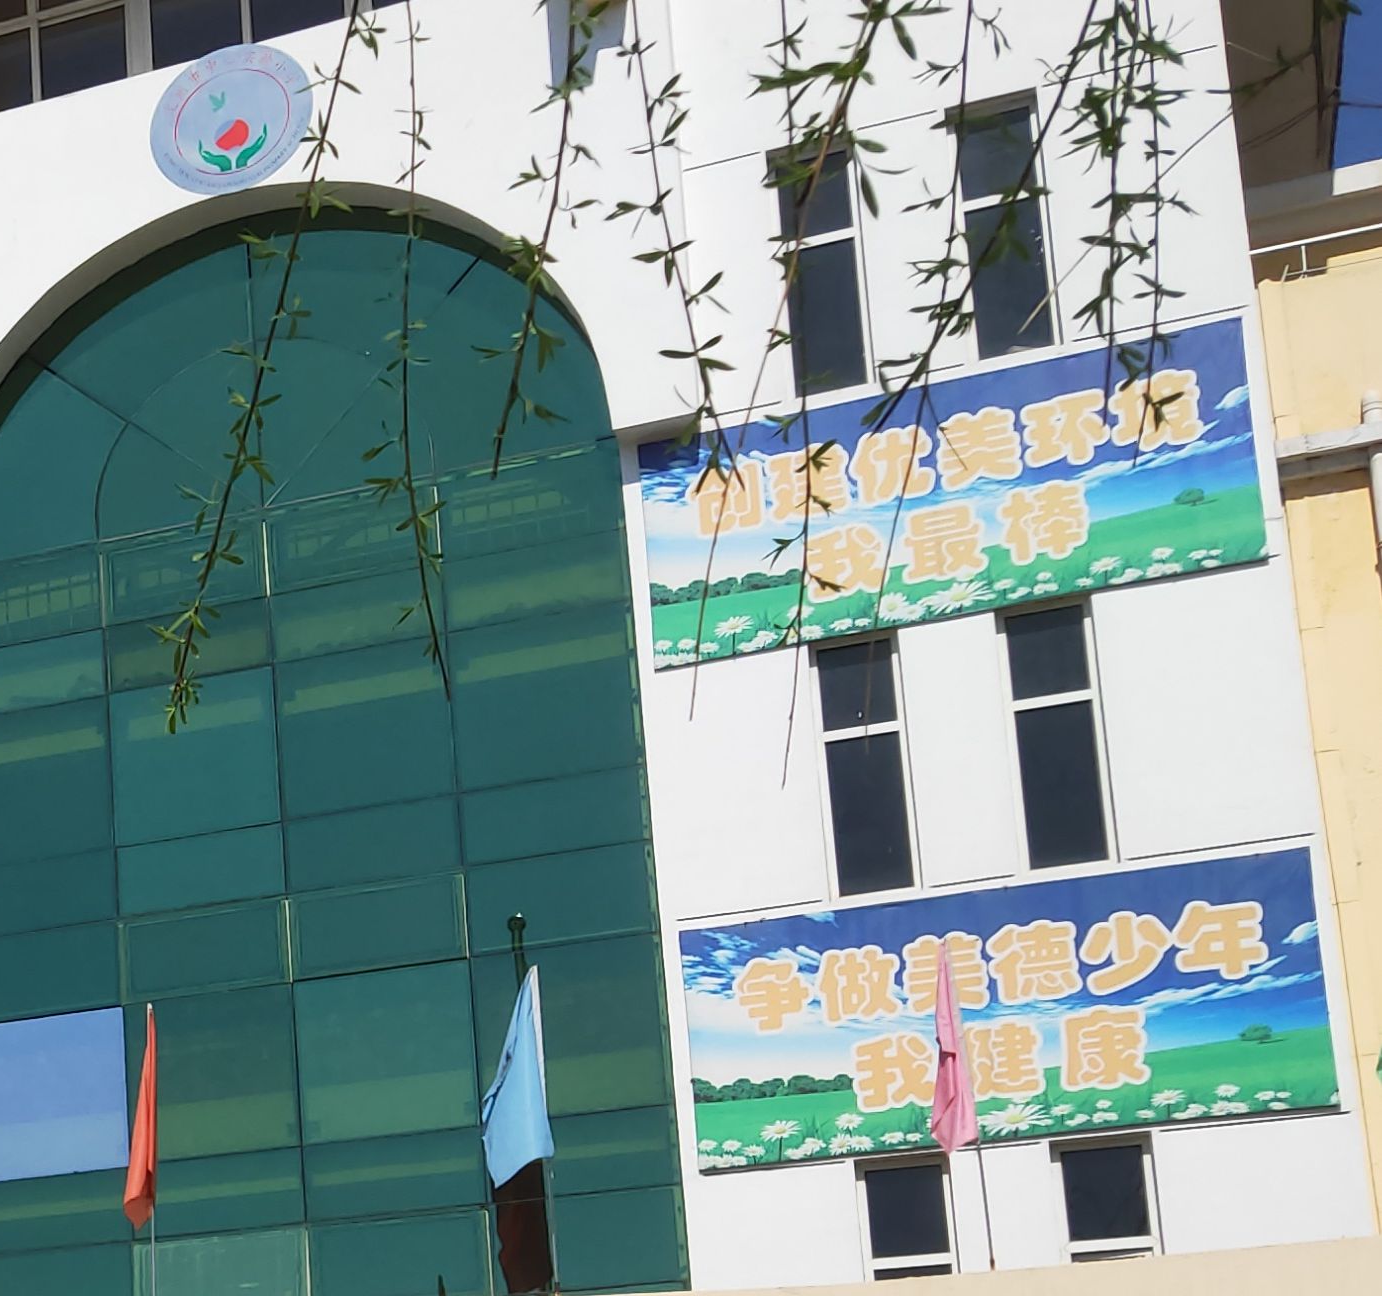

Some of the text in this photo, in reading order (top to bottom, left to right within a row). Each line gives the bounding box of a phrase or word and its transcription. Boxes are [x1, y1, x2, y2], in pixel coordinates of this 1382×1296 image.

[686, 367, 1205, 537] 创建优美环境
[805, 477, 1090, 605] 我最棒
[737, 900, 1268, 1035] 争做美德少年
[852, 1004, 1151, 1114] 我健康
